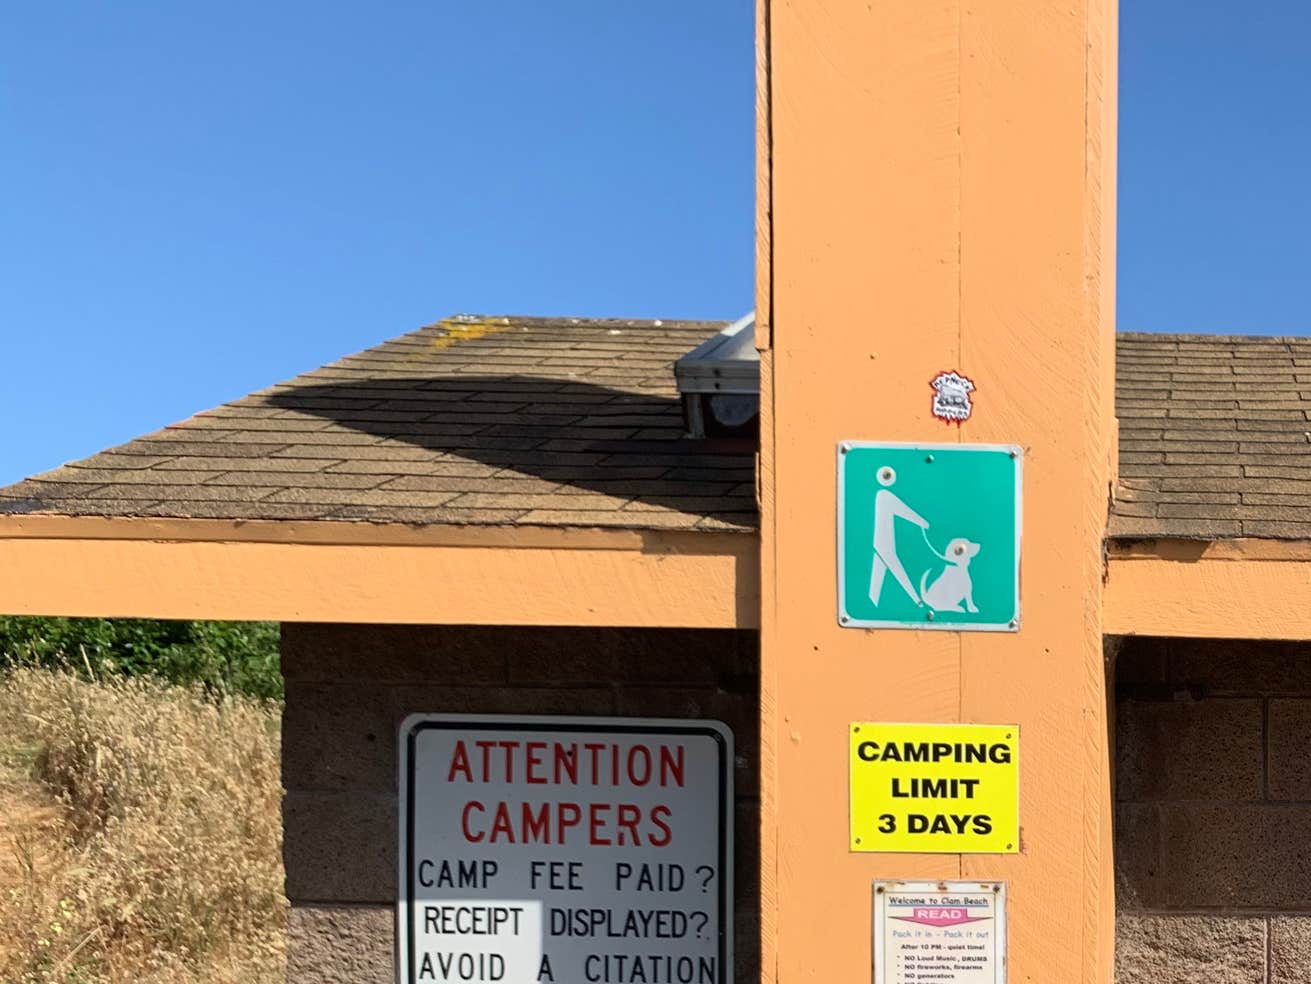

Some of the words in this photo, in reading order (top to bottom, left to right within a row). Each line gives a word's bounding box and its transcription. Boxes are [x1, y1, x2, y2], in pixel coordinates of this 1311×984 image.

[447, 739, 684, 787] ATTENTION
[857, 740, 1010, 764] CAMPING
[891, 777, 979, 798] LIMIT
[461, 800, 672, 847] CAMPERS
[878, 813, 896, 833] 3
[907, 813, 992, 835] DAYS
[418, 859, 498, 889] CAMP
[530, 861, 583, 890] FEE
[888, 896, 925, 905] Welcome
[941, 897, 961, 905] Clam
[964, 897, 988, 905] Beach
[917, 909, 962, 919] READ
[424, 905, 523, 935] RECEIPT
[551, 908, 708, 938] DISPLAYED?
[418, 951, 505, 981] AVOID
[537, 953, 553, 981] A
[585, 954, 714, 984] CITATION
